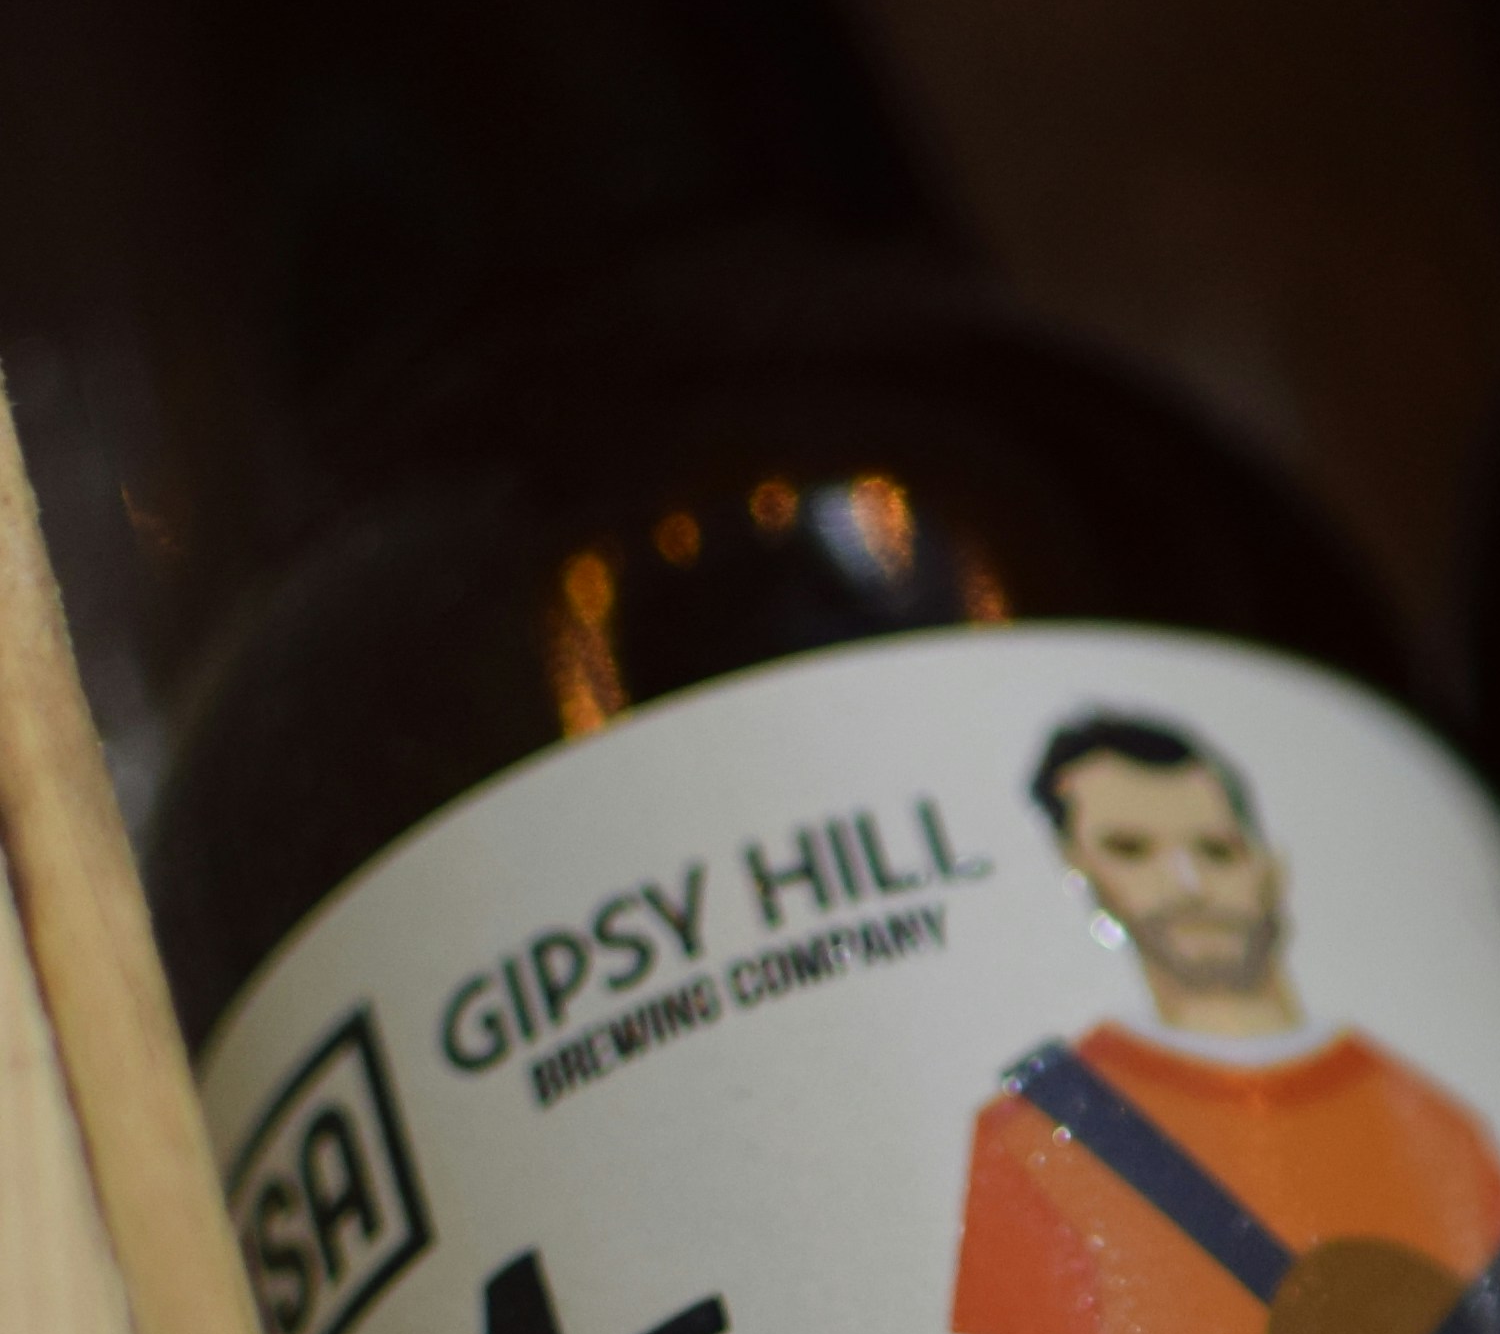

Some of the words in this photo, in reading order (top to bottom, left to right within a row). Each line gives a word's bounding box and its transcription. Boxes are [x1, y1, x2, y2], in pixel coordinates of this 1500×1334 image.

[437, 861, 708, 1077] GIPSY
[744, 795, 994, 929] HILL
[530, 977, 722, 1109] BREWING
[730, 904, 949, 1010] COMPANY
